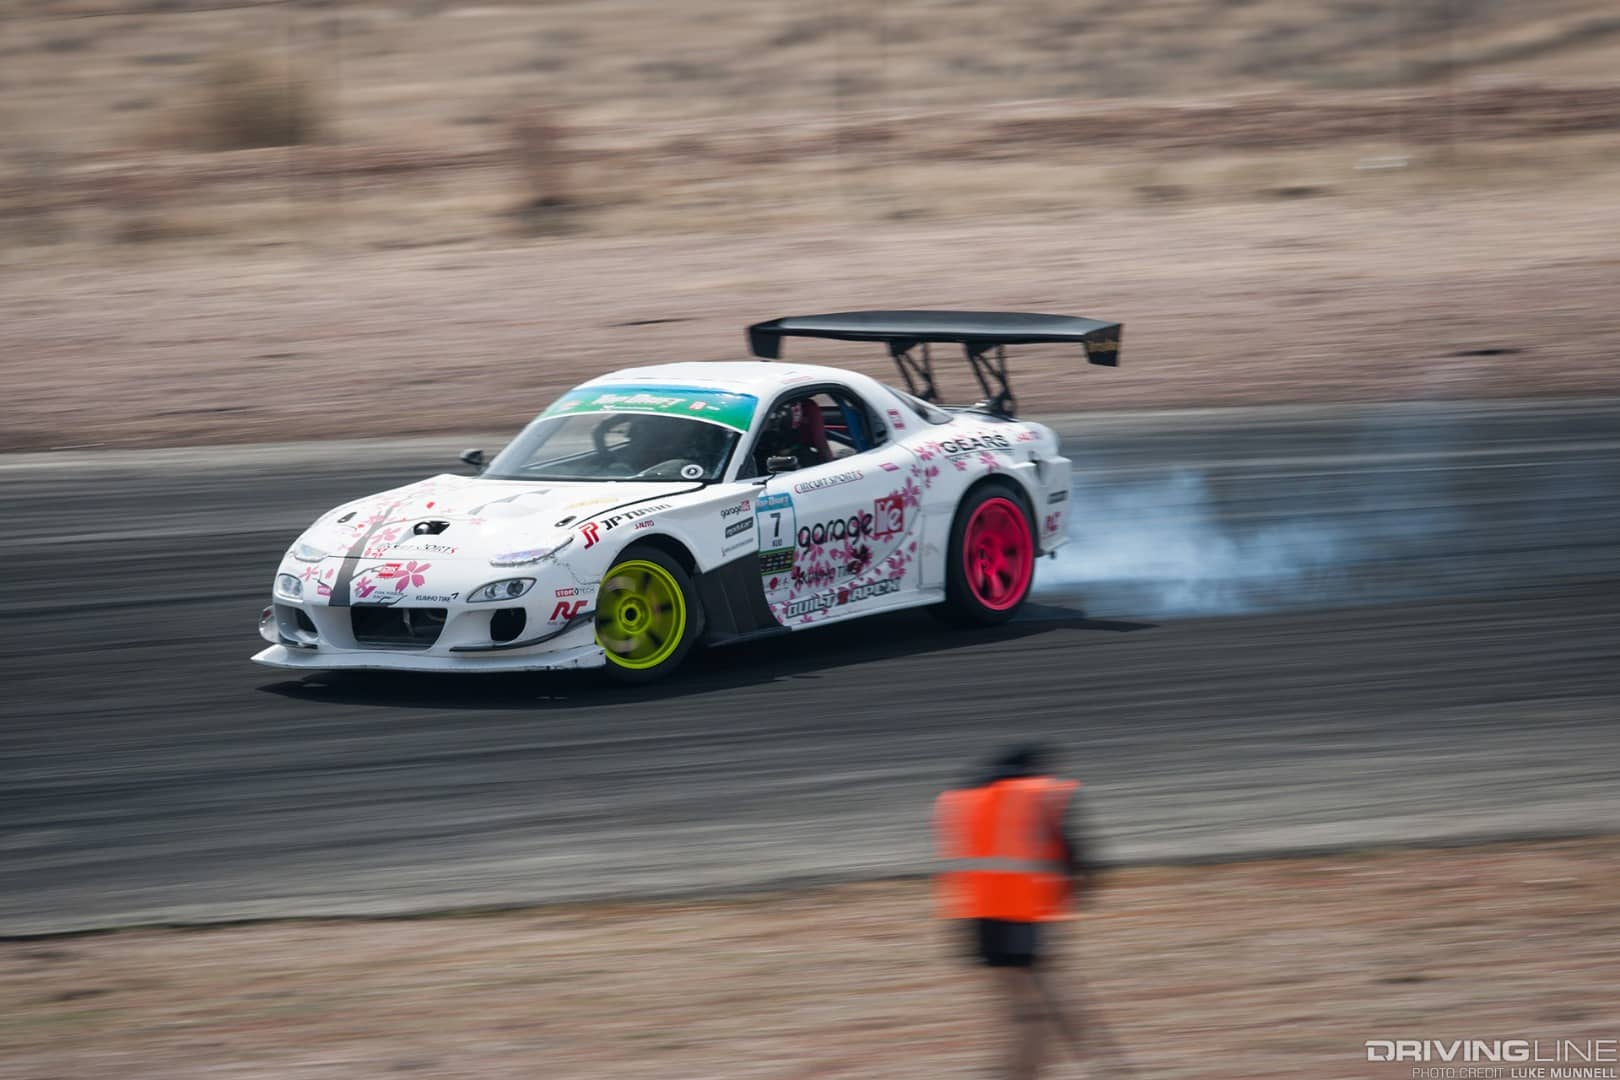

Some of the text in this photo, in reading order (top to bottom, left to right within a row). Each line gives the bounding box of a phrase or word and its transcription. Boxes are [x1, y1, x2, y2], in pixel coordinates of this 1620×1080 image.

[942, 434, 1011, 454] GEARS
[770, 512, 781, 538] 7
[798, 513, 873, 556] garage
